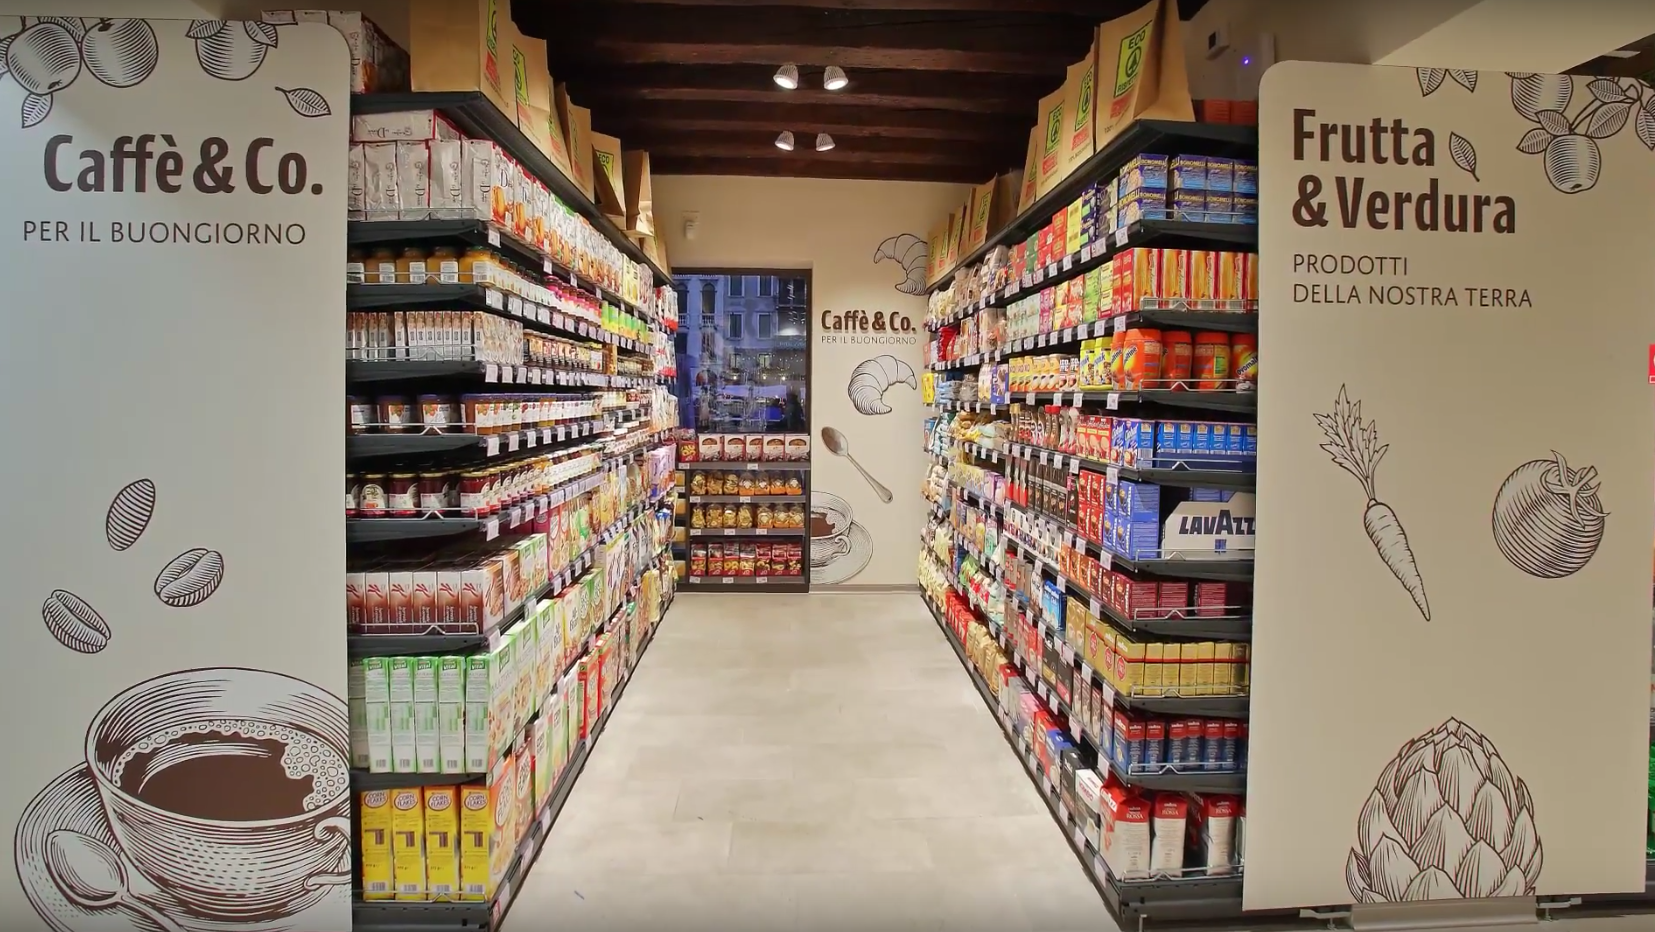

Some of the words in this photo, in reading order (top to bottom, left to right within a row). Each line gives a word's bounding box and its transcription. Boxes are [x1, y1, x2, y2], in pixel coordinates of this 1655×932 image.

[1128, 29, 1146, 49] ECO
[1293, 108, 1435, 167] Frutta
[44, 133, 184, 194] Caffè
[193, 136, 236, 195] &
[245, 136, 324, 196] Co.
[1335, 176, 1516, 234] Verdura
[23, 220, 70, 242] PER
[81, 221, 101, 243] IL
[111, 221, 307, 245] BUONGIORNO
[1293, 253, 1408, 276] PRODOTTI
[1293, 283, 1361, 305] DELLA
[1369, 285, 1459, 307] NOSTRA
[1464, 287, 1533, 308] TERRA
[821, 309, 869, 331] Caffè
[871, 310, 887, 332] &
[889, 311, 916, 332] Co.
[821, 335, 837, 344] PER
[840, 335, 848, 344] IL
[850, 335, 917, 346] BUONGIORNO
[1179, 509, 1256, 535] LAVAZZ
[368, 791, 385, 799] CORN
[397, 799, 416, 807] FLAKES
[399, 793, 415, 801] CORN
[431, 794, 449, 802] CORN
[466, 799, 487, 807] FLAKES
